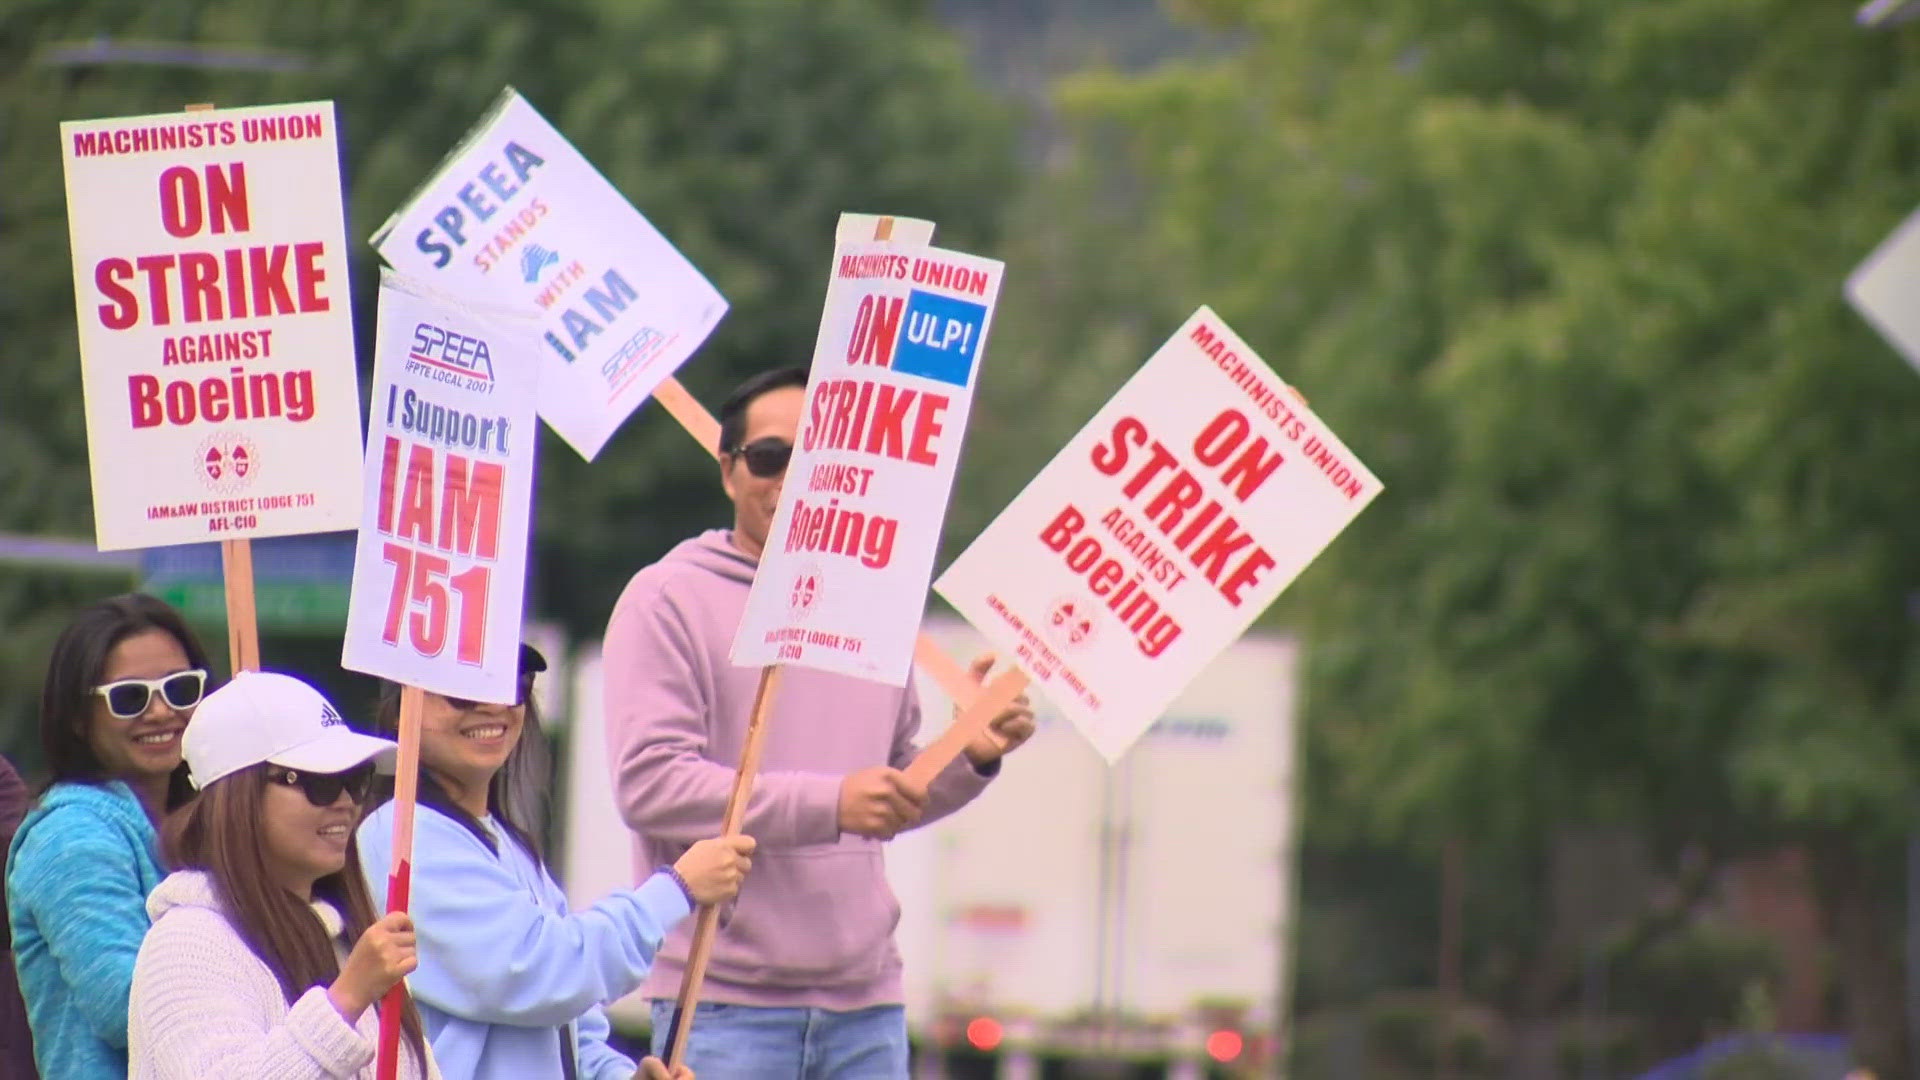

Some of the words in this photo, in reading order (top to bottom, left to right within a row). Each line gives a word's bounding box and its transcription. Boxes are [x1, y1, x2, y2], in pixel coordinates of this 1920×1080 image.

[73, 121, 236, 157] MACHINISTS
[241, 113, 322, 144] UNION
[159, 161, 250, 238] ON
[415, 140, 545, 269] SPEEA
[473, 198, 547, 274] STANDS
[95, 241, 330, 330] STRIKE
[535, 259, 585, 310] WITH
[838, 255, 908, 279] MACHINISTS
[912, 258, 988, 296] UNION
[162, 329, 272, 366] AGAINST
[410, 323, 495, 381] SPEEA
[543, 268, 639, 364] IAM
[847, 294, 904, 368] ON
[907, 310, 973, 355] ULP!
[128, 367, 315, 429] Boeing
[405, 359, 431, 378] IFPTE
[432, 367, 462, 387] LOCAL
[466, 379, 495, 395] 2001
[1190, 324, 1306, 441] MACHINISTS
[1303, 436, 1363, 499] UNION
[386, 384, 397, 426] I
[402, 388, 510, 454] Support
[803, 379, 950, 467] STRIKE
[808, 463, 874, 497] AGAINST
[1193, 409, 1285, 503] ON
[147, 503, 198, 520] IAM&AW
[201, 499, 254, 515] DISTRICT
[258, 495, 292, 510] LODGE
[296, 493, 315, 506] 751
[209, 515, 257, 532] AFL-CIO
[377, 434, 505, 561] IAM
[784, 498, 898, 569] Boeing
[1090, 416, 1276, 608] STRIKE
[1039, 503, 1182, 659] Boeing
[1101, 507, 1187, 592] AGAINST
[382, 542, 491, 668] 751
[807, 630, 840, 648] LODGE
[843, 638, 862, 653] 751
